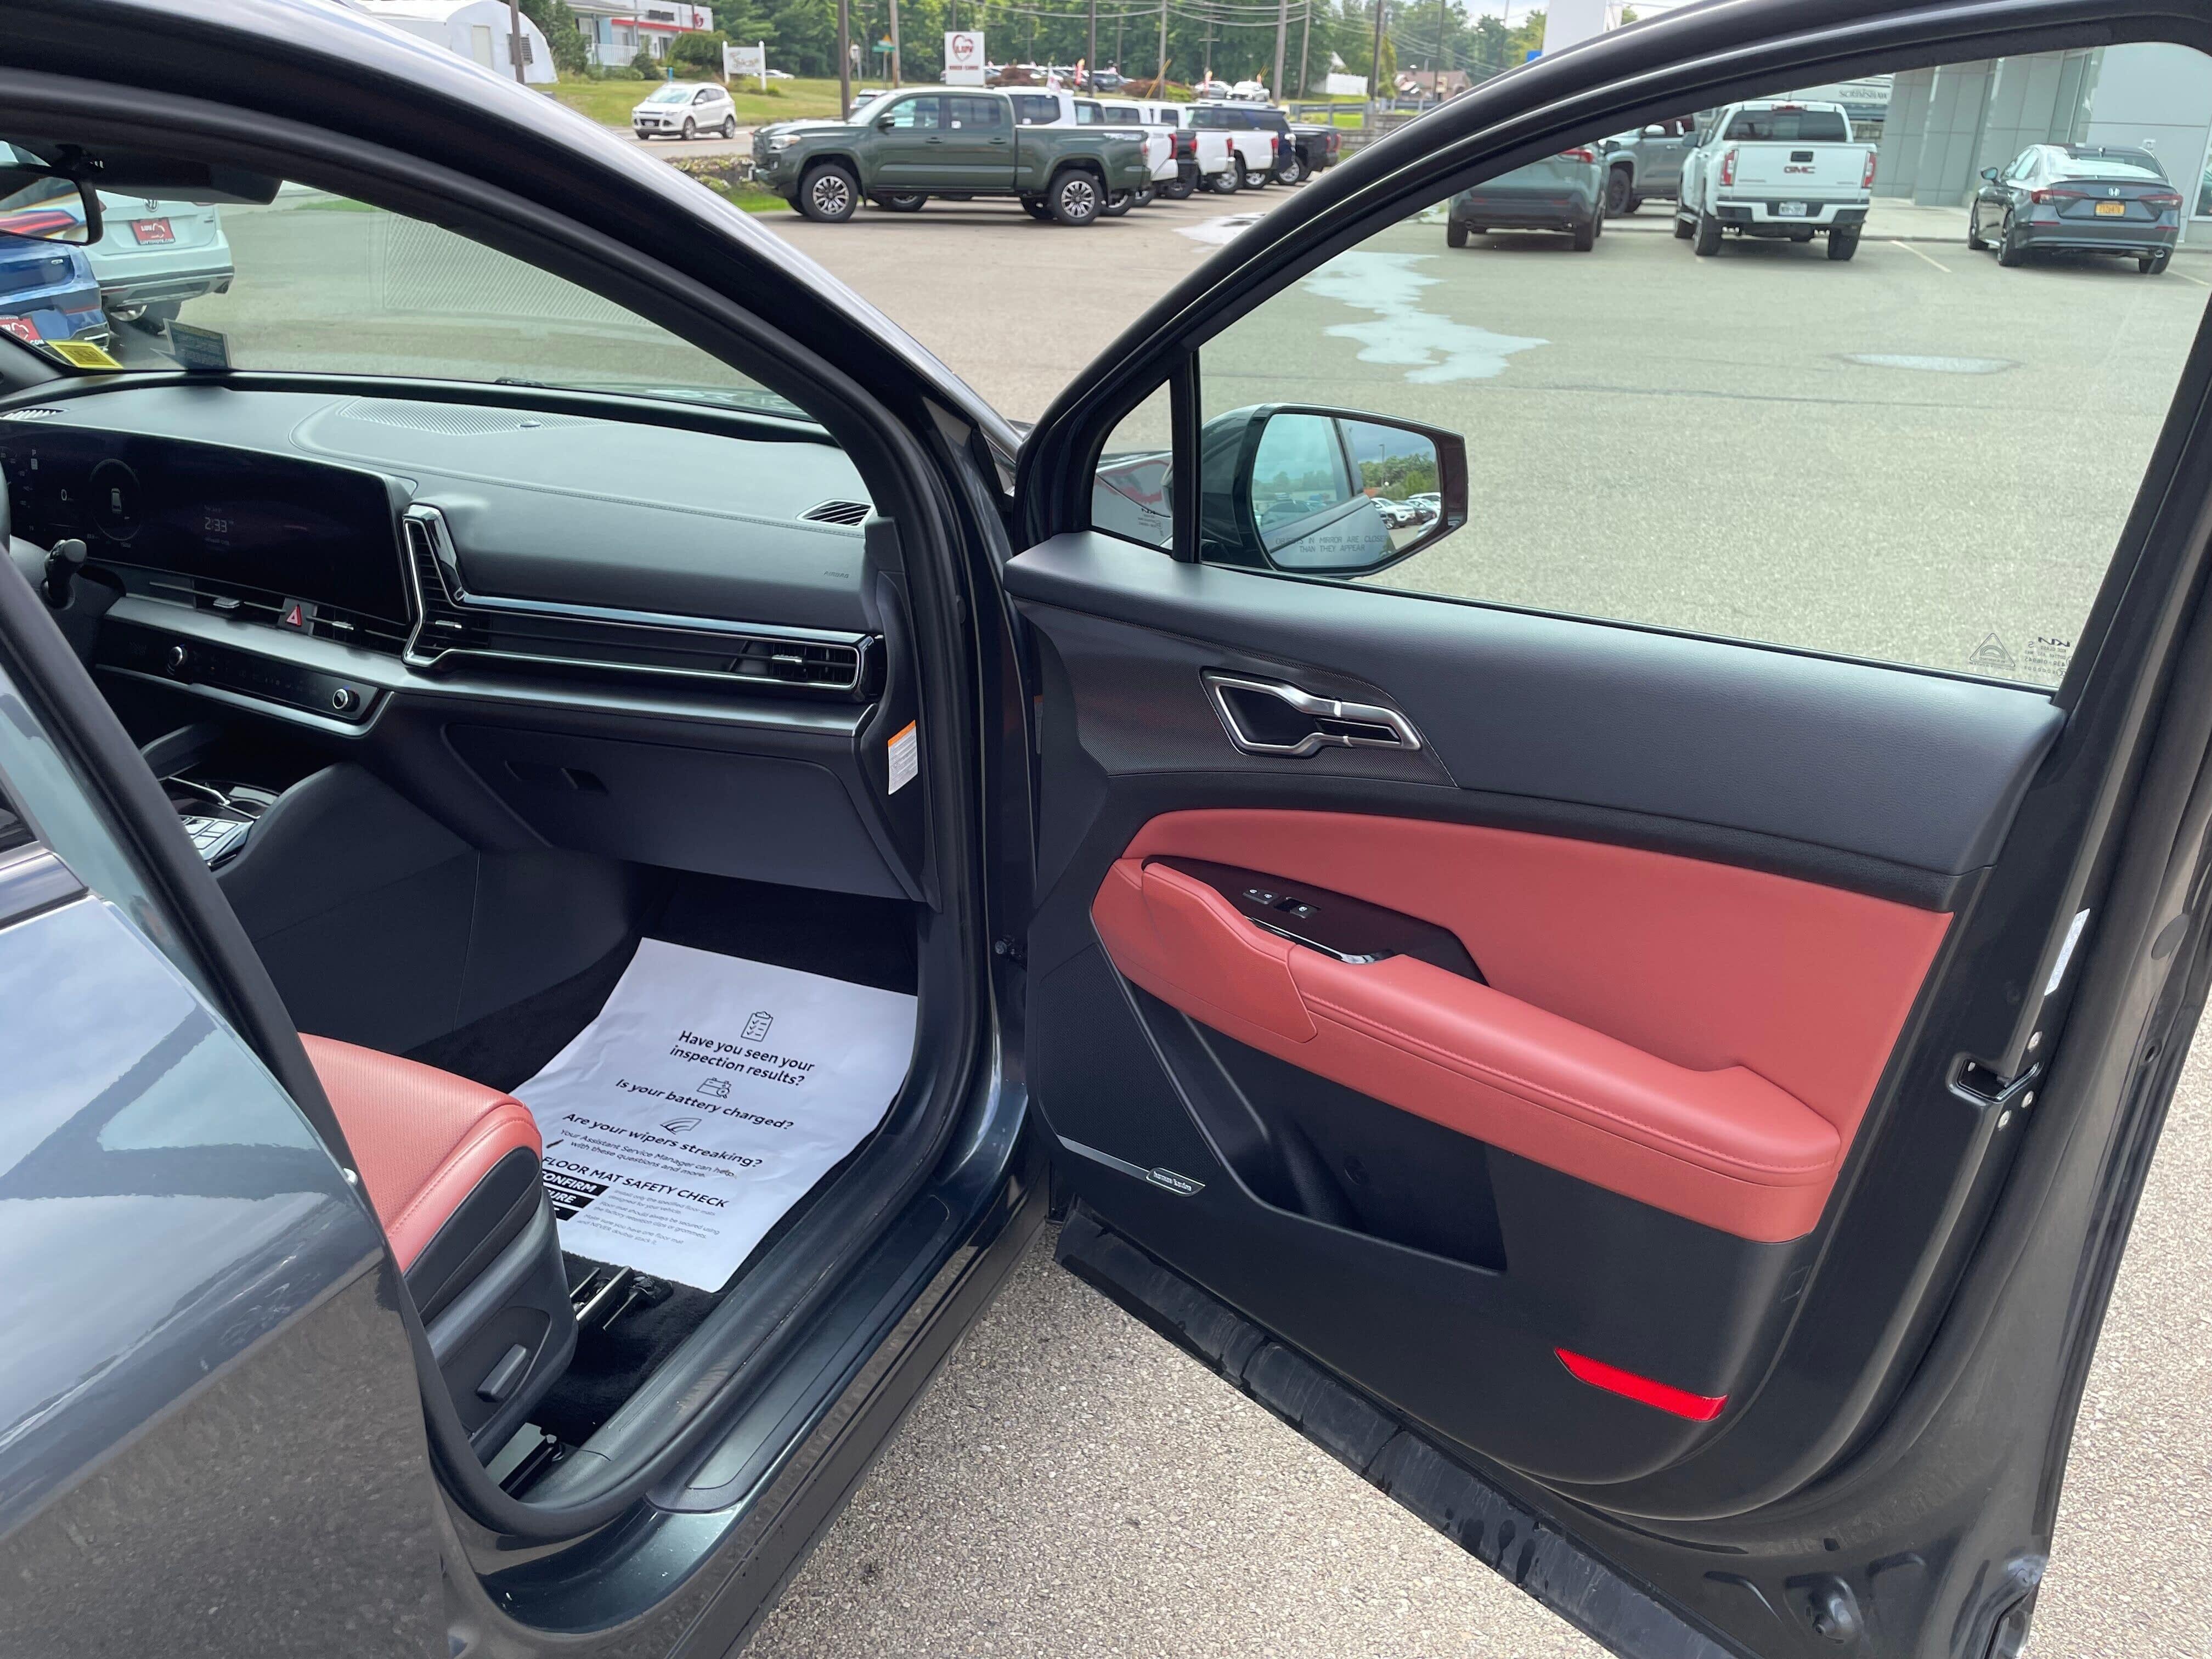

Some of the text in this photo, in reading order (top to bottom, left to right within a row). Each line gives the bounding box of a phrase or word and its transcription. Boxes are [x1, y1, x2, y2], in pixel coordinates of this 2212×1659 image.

[1784, 166, 1815, 174] GMC
[204, 517, 227, 533] 2:33
[670, 1045, 805, 1086] inspection results?
[679, 1030, 815, 1071] Have you seen your
[616, 1079, 794, 1130] Is your battery charged?
[560, 1129, 580, 1138] Your
[582, 1135, 621, 1150] Assistant
[621, 1146, 653, 1158] Service
[654, 1153, 695, 1169] Manager
[562, 1113, 763, 1167] Are your wipers streaking?
[571, 1141, 590, 1150] with
[591, 1146, 616, 1157] these
[617, 1153, 659, 1167] questions
[661, 1164, 680, 1172] and
[542, 1156, 730, 1208] FLOOR MAT SAFETY CHECK
[542, 1171, 597, 1193] ONFIRM
